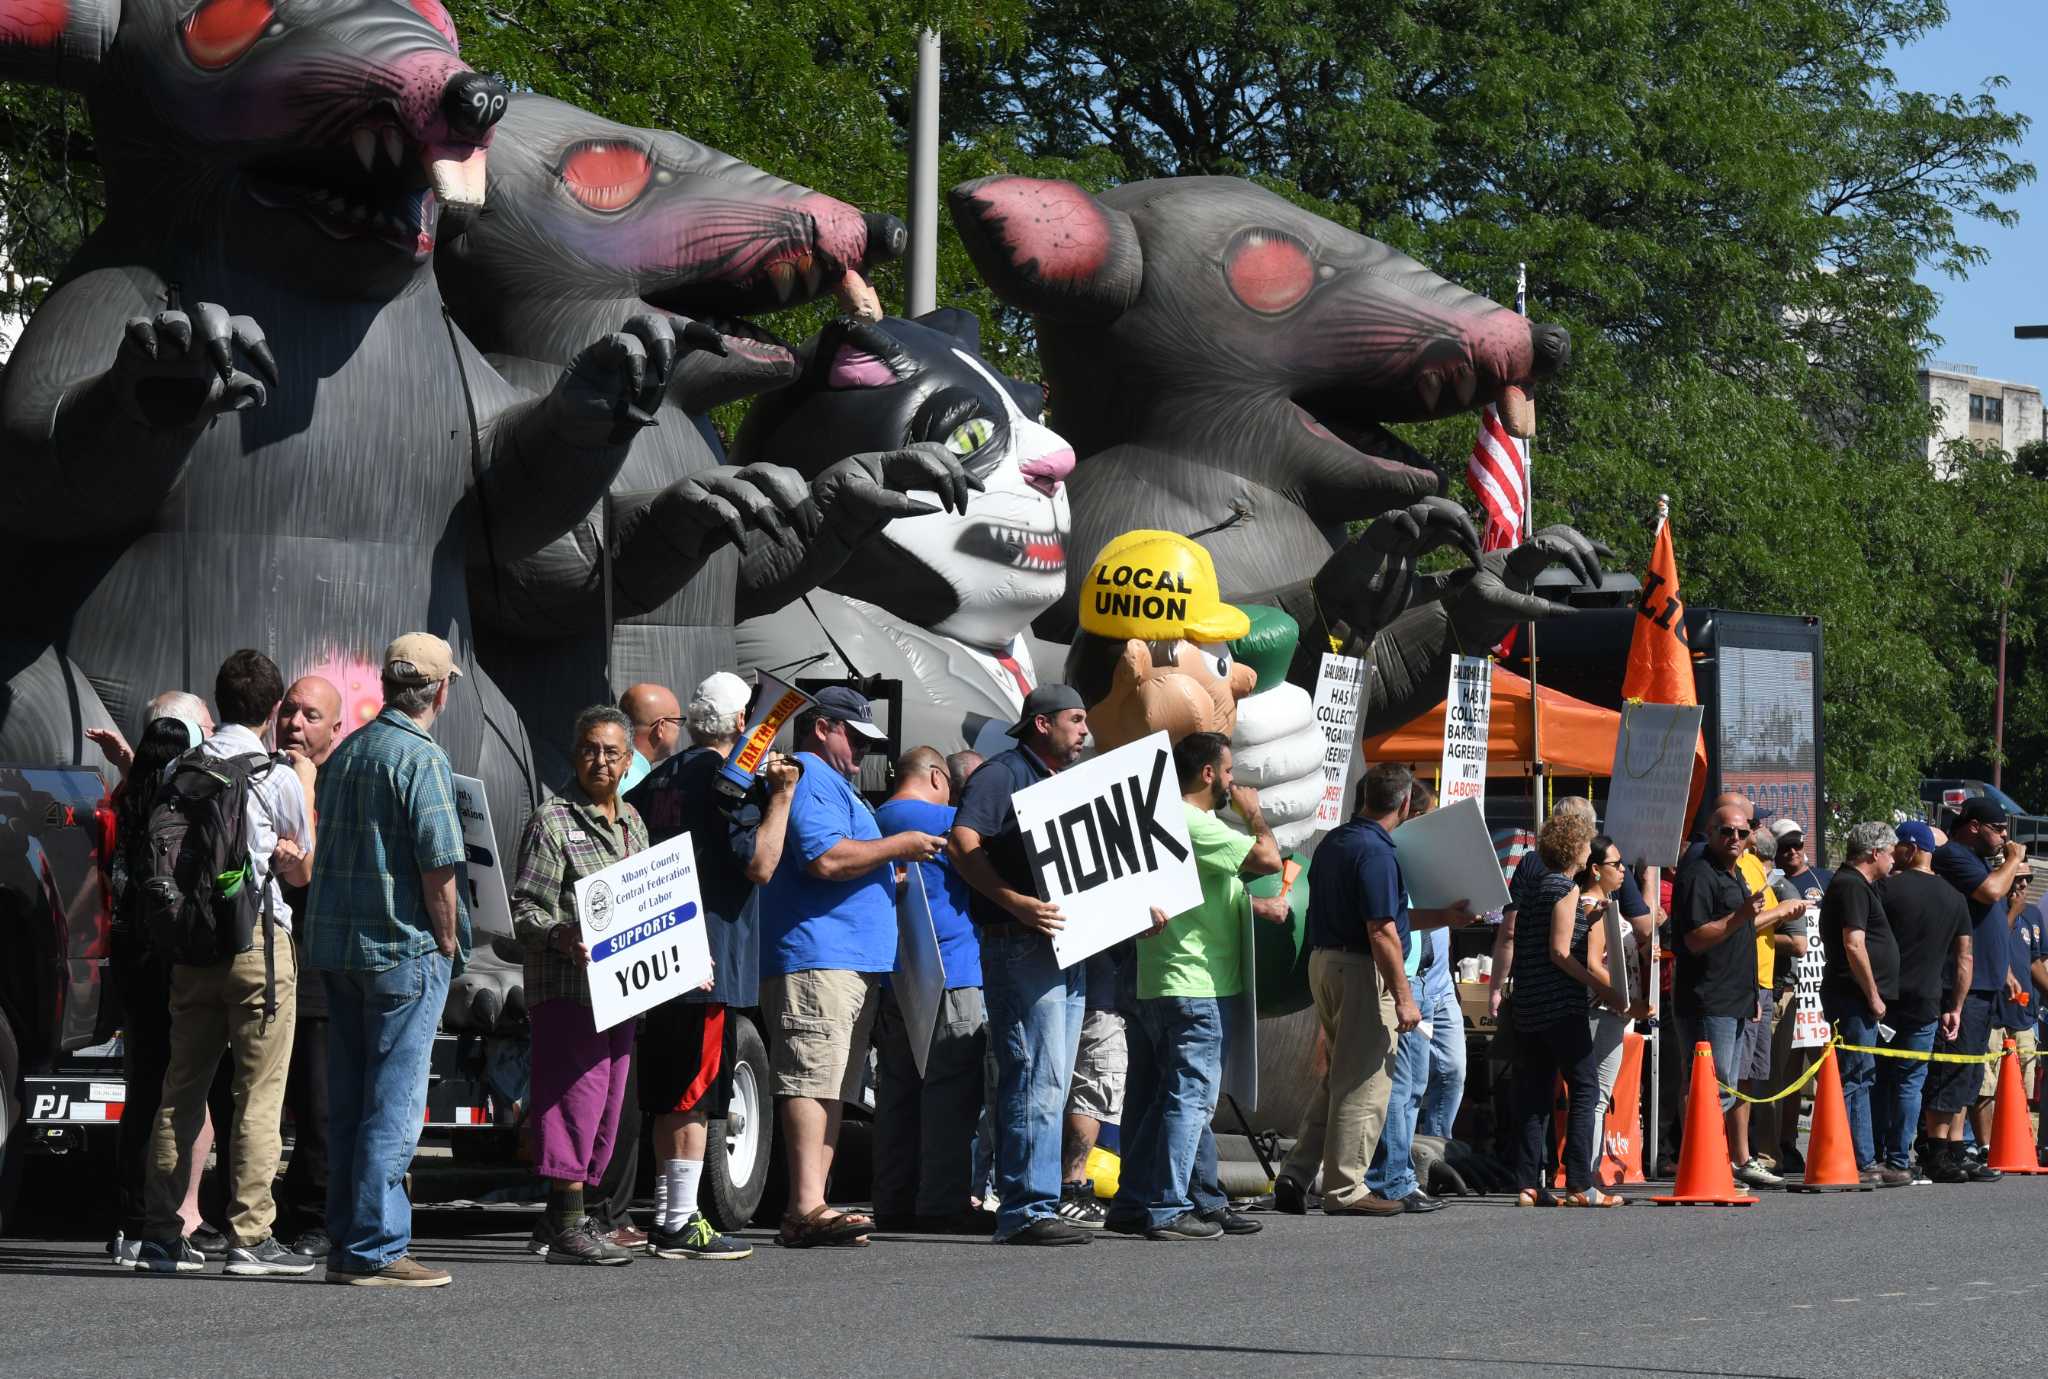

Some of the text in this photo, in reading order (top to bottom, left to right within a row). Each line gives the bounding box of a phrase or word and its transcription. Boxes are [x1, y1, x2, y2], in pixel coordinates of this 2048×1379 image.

[1096, 565, 1192, 594] LOCAL
[1095, 592, 1186, 621] UNION
[1330, 687, 1350, 706] HAS
[1463, 687, 1479, 704] HAS
[737, 743, 762, 768] TAX
[1463, 764, 1479, 779] WITH
[456, 790, 472, 802] nty
[462, 807, 484, 821] ation
[1021, 748, 1189, 903] HONK
[621, 851, 680, 884] Albany County
[616, 865, 691, 904] Central Federation
[638, 890, 672, 912] of Labor
[610, 911, 676, 953] SUPPORTS
[615, 945, 680, 997] YOU!
[1796, 996, 1816, 1009] TH
[1811, 1026, 1829, 1041] 19
[32, 1095, 69, 1118] PJ
